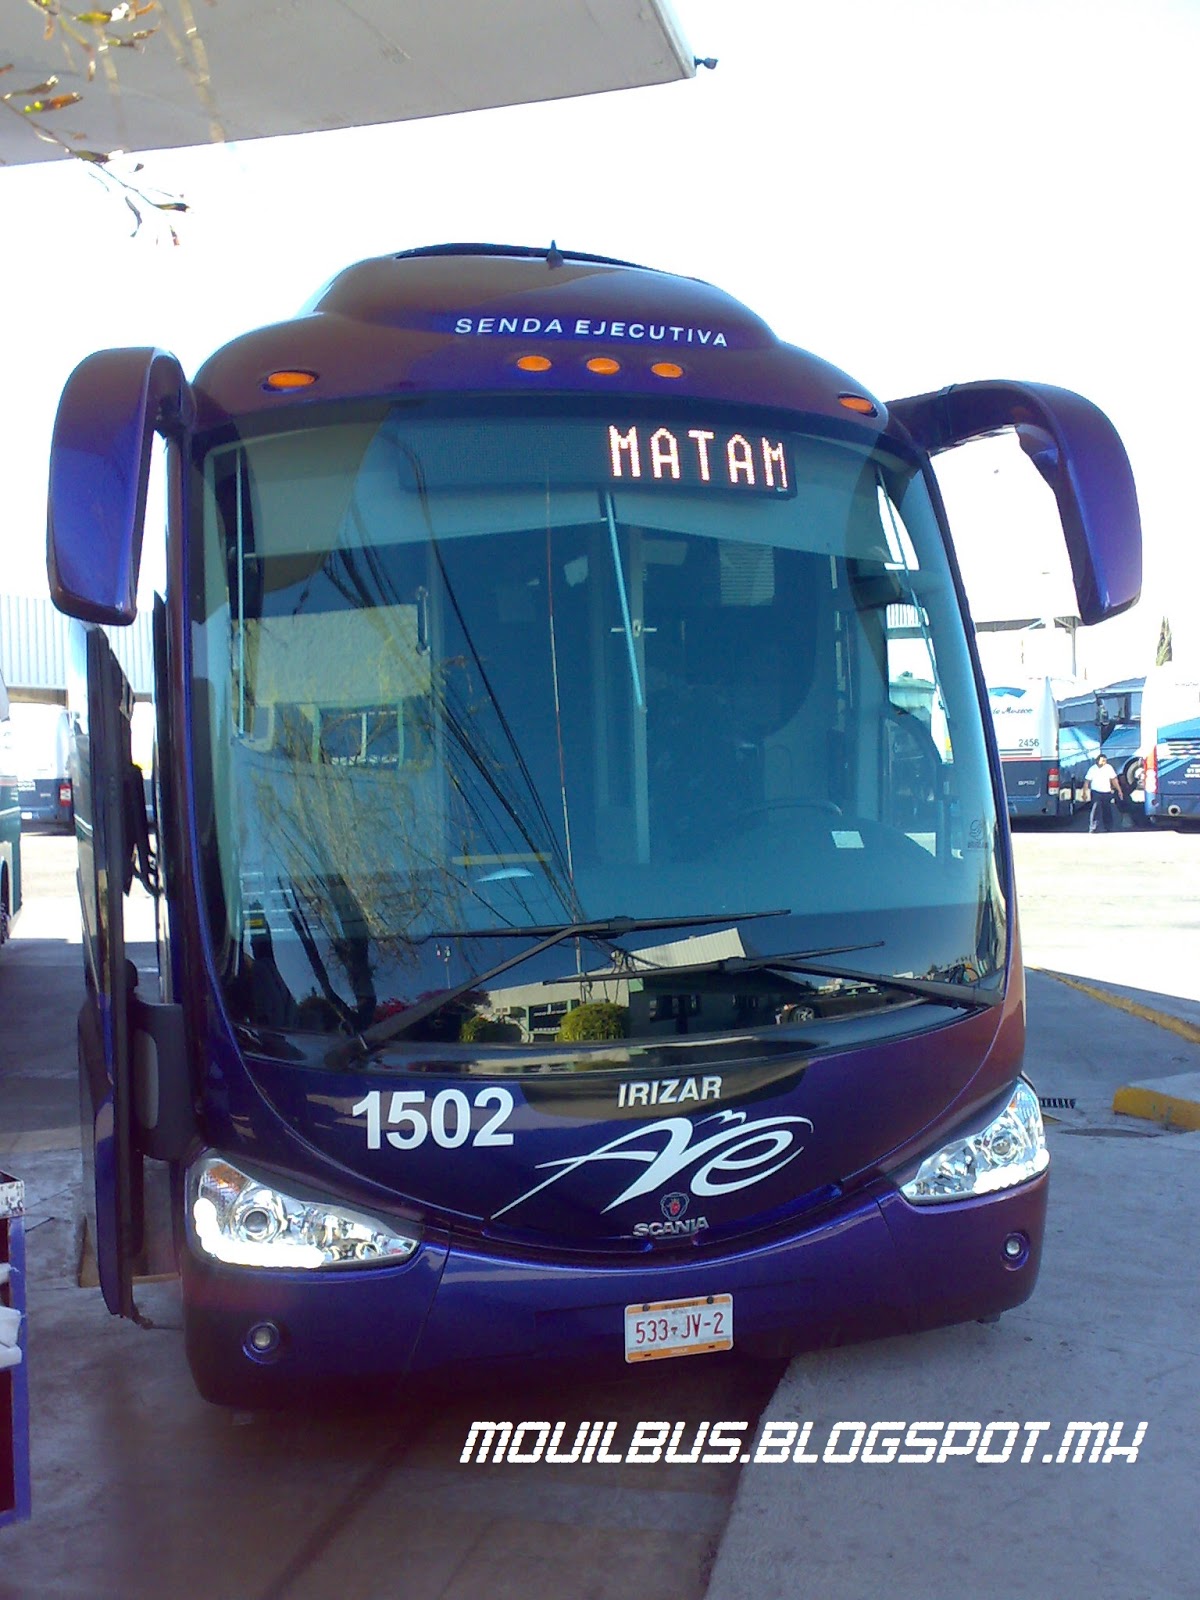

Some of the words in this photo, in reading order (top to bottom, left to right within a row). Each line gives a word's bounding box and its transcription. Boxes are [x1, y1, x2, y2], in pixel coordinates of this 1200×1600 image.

[455, 317, 563, 334] SENDA
[575, 319, 728, 347] EJECUTIVA
[608, 424, 788, 488] MATAM
[1018, 738, 1040, 748] 2456
[617, 1075, 723, 1109] IRIZAR
[351, 1087, 515, 1150] 1502
[632, 1216, 710, 1237] SCANIA
